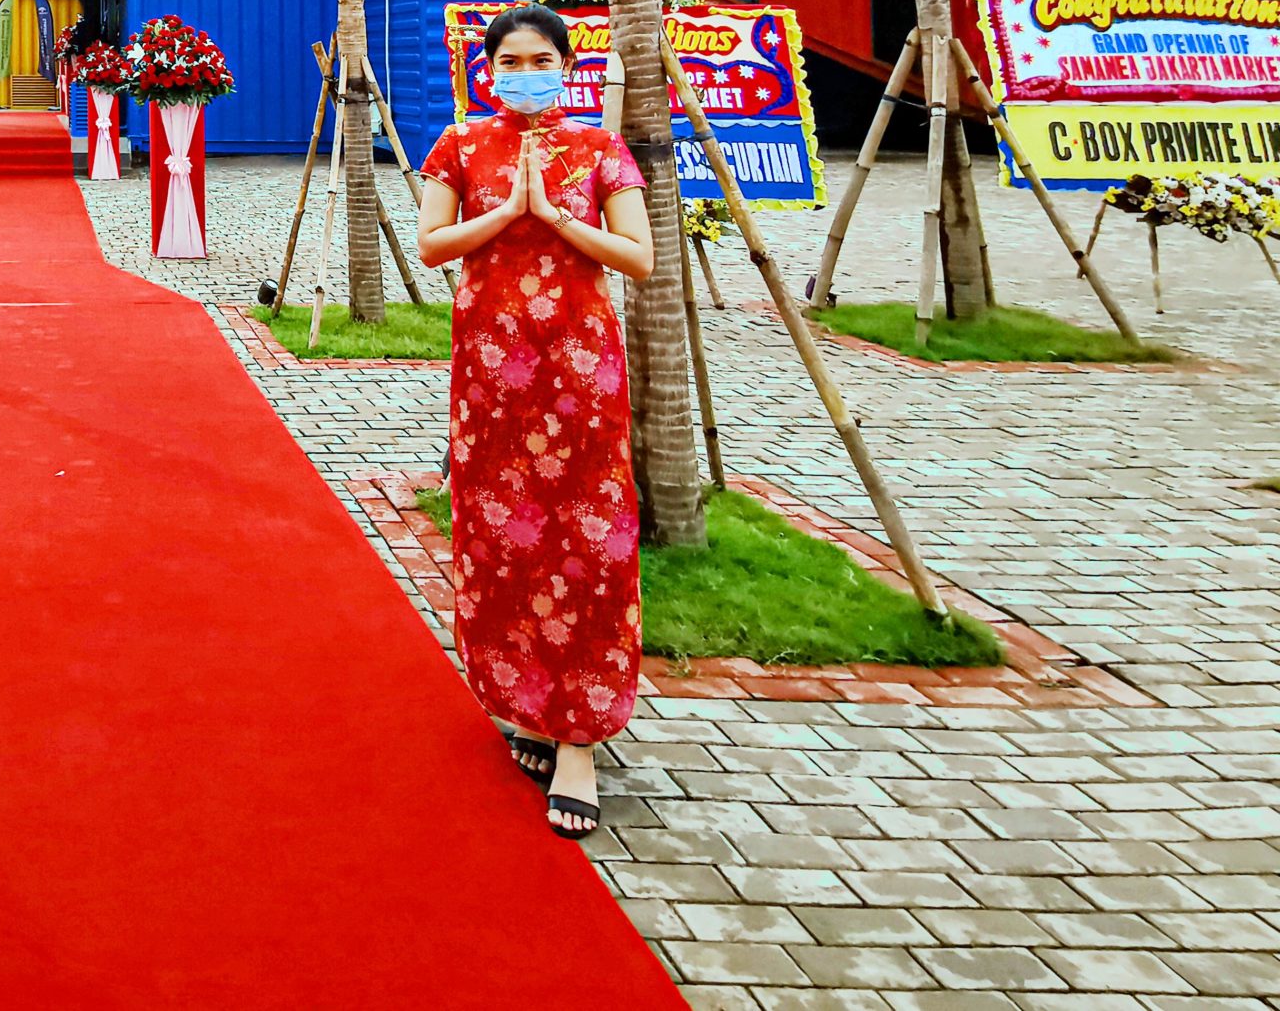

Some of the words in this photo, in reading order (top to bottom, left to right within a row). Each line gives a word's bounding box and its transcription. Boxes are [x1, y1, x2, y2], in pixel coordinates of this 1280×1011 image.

[1092, 33, 1148, 54] GRAND
[1153, 33, 1225, 55] OPENING
[1229, 34, 1249, 55] OF
[687, 72, 706, 84] OF
[1058, 55, 1141, 81] SAMANEA
[1142, 55, 1222, 81] JAKARTA
[1221, 55, 1280, 81] MARKE
[1140, 121, 1241, 164] PRIVATE
[719, 141, 804, 184] CURTAIN
